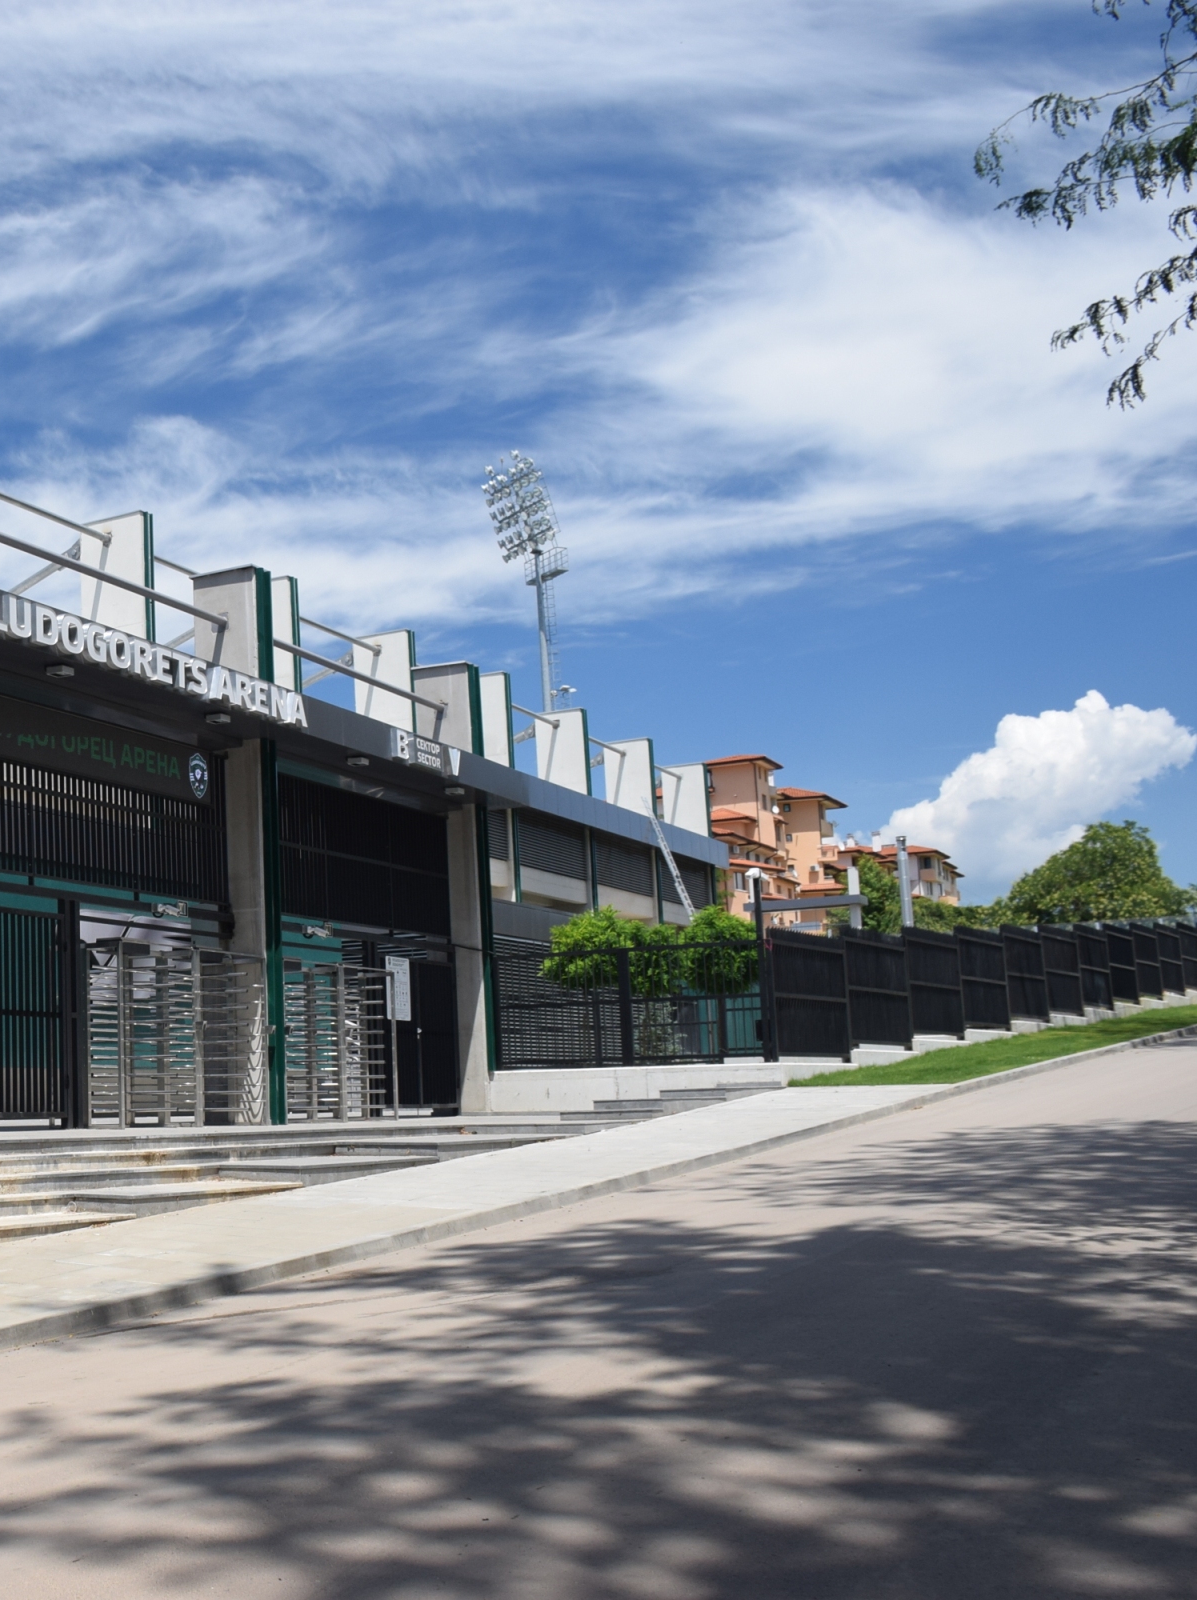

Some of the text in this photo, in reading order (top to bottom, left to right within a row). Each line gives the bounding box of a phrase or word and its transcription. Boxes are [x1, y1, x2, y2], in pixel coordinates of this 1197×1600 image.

[208, 666, 309, 728] ARENA
[120, 743, 181, 779] АРЕНА
[416, 738, 440, 755] СЕКТОР
[417, 752, 441, 769] SECTOR
[448, 747, 461, 776] V
